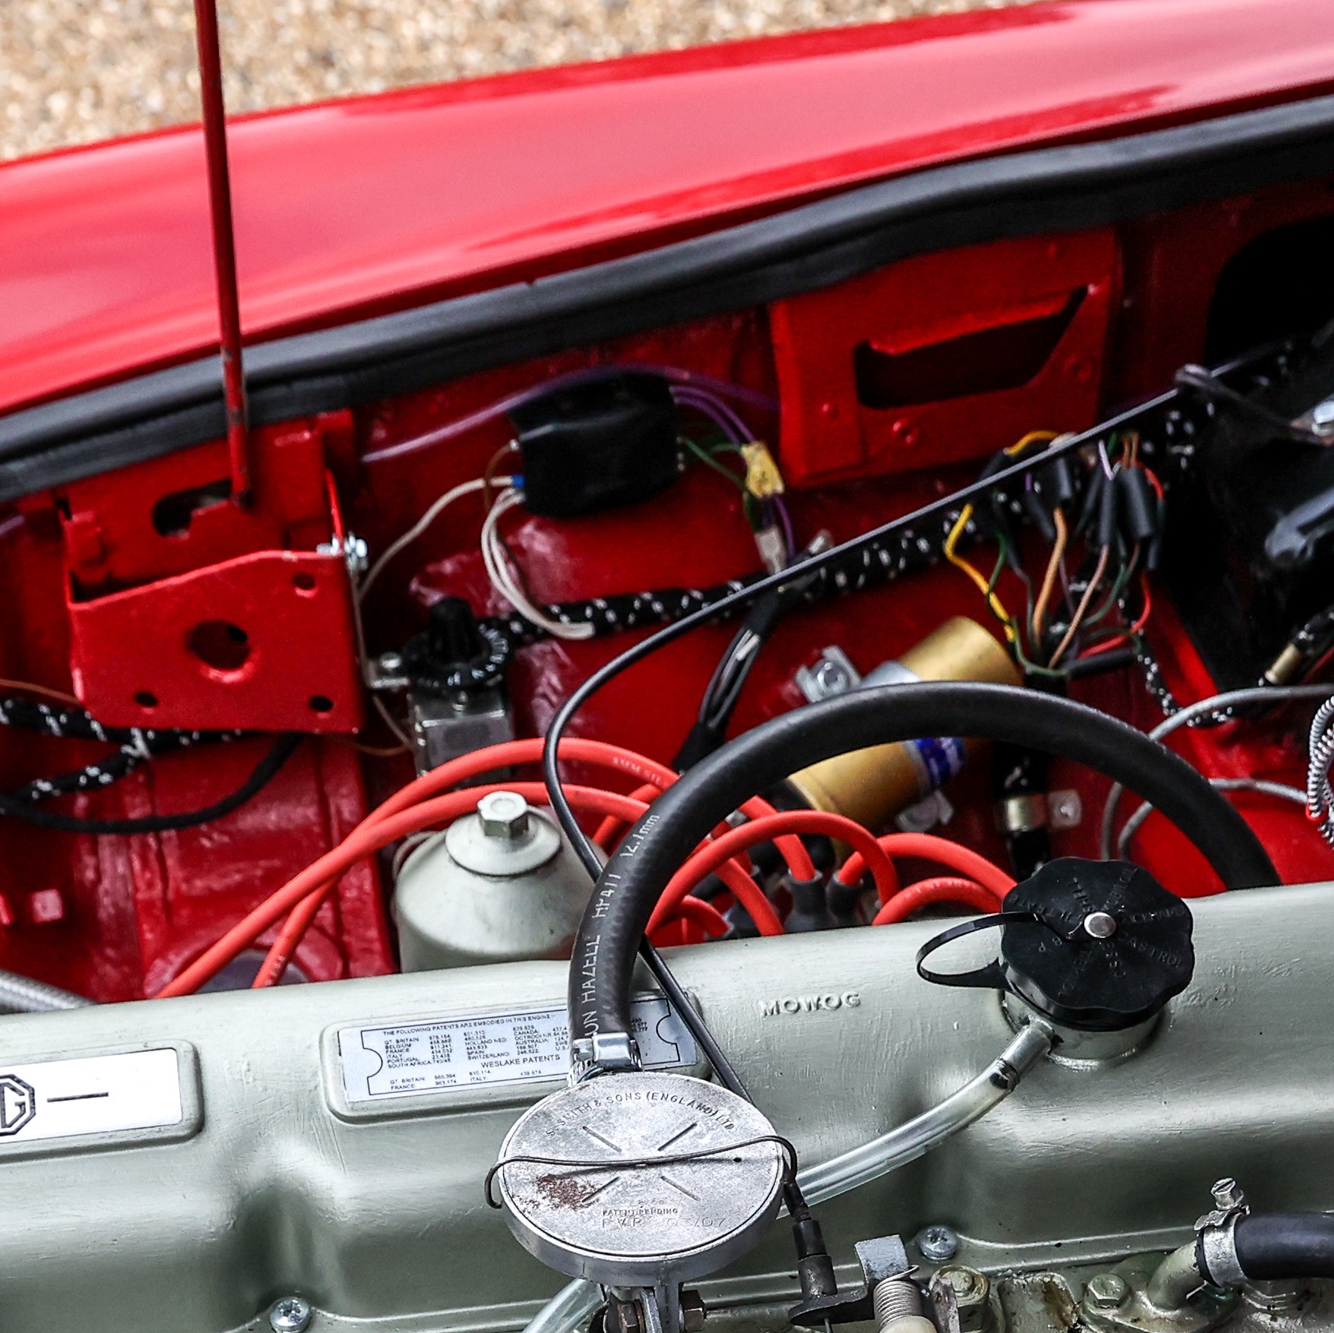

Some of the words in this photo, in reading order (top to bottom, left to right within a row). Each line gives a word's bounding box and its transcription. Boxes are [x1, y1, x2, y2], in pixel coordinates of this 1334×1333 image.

[759, 991, 861, 1017] MOWOG
[481, 1058, 521, 1069] WESLAKE
[522, 1054, 561, 1064] PATENTS
[594, 1098, 604, 1108] &
[606, 1091, 643, 1105] SONS
[646, 1091, 719, 1120] (ENGLAND)
